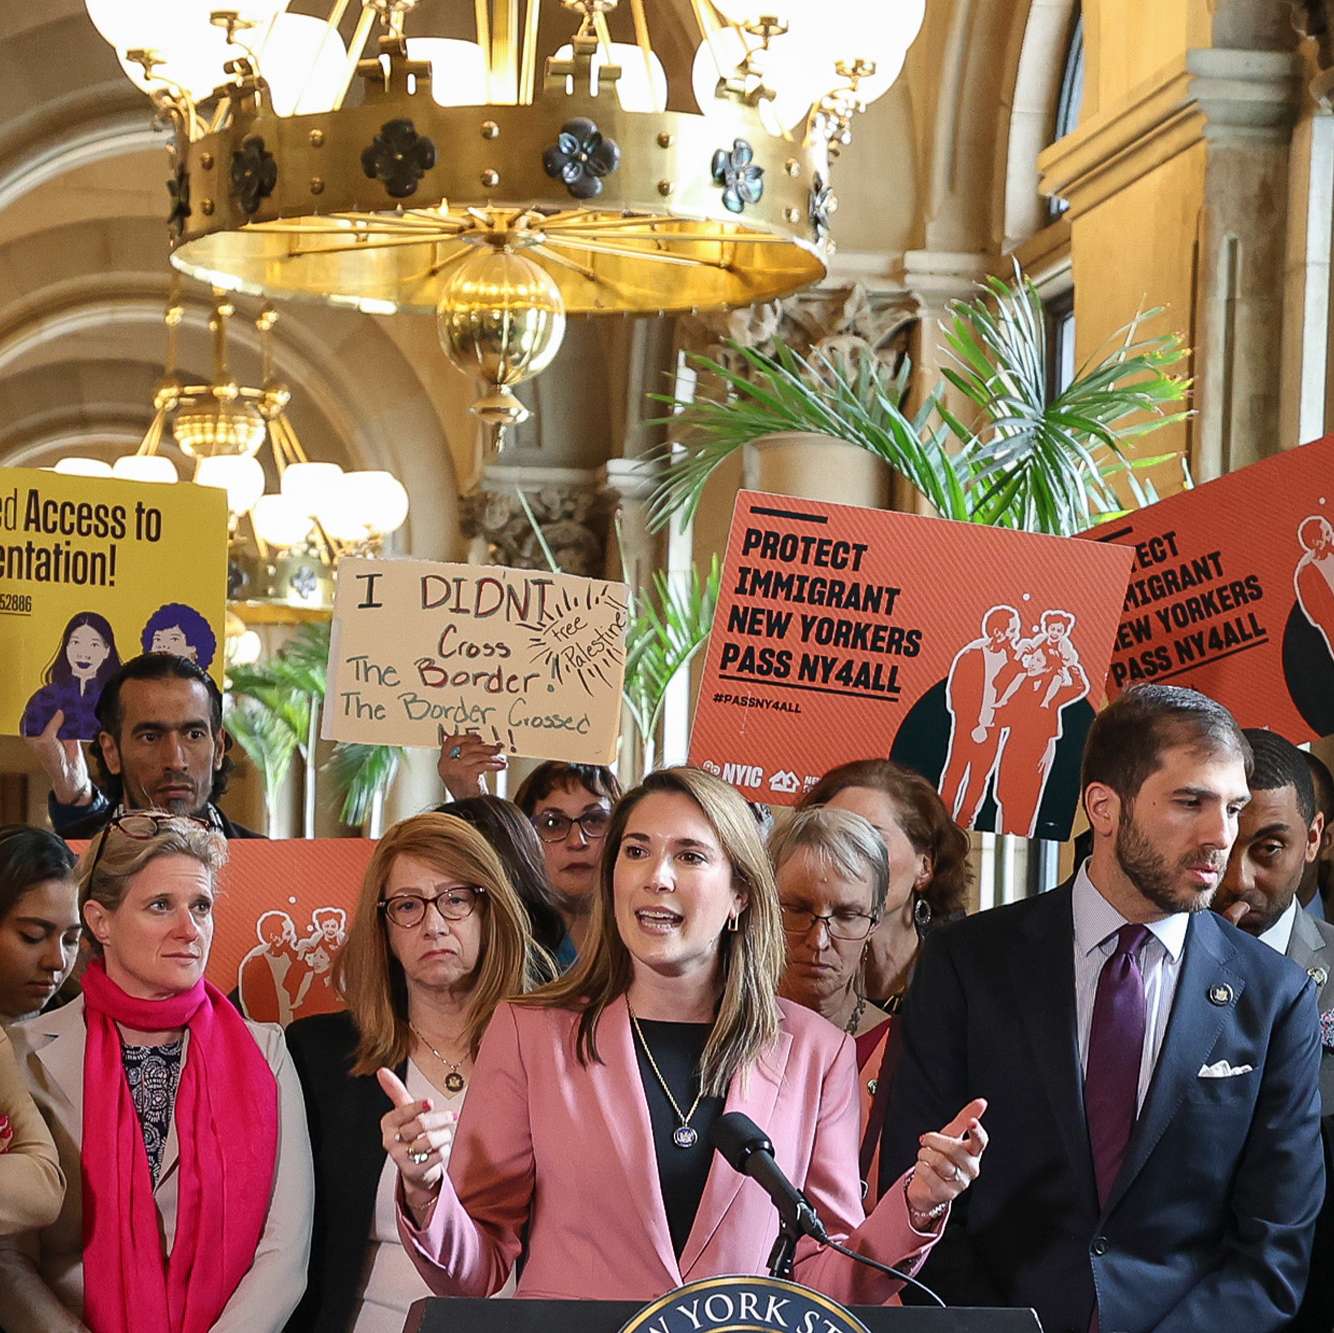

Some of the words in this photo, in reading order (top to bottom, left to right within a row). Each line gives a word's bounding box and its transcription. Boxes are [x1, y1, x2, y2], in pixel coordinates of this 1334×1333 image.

[23, 489, 126, 539] Access
[135, 501, 162, 542] to
[741, 527, 868, 572] PROTECT
[355, 573, 383, 609] I
[734, 566, 901, 616] IMMIGRANT
[1123, 551, 1223, 612] MIGRANT
[0, 594, 32, 612] 52886
[1115, 615, 1152, 652] EW
[1155, 574, 1263, 633] YORKERS
[437, 624, 512, 659] Cross
[728, 604, 793, 640] NEW
[800, 614, 923, 658] YORKERS
[1111, 646, 1173, 688] PASS
[1174, 612, 1267, 664] NY4ALL
[346, 655, 401, 688] The
[719, 643, 793, 679] PASS
[798, 654, 902, 694] NY4ALL
[341, 692, 386, 720] The
[397, 692, 497, 726] Border
[507, 698, 591, 734] Crossed
[713, 693, 802, 713] #PASSNY4ALL
[722, 762, 764, 788] NYIC
[804, 775, 822, 785] NE
[677, 1292, 792, 1331] YORK
